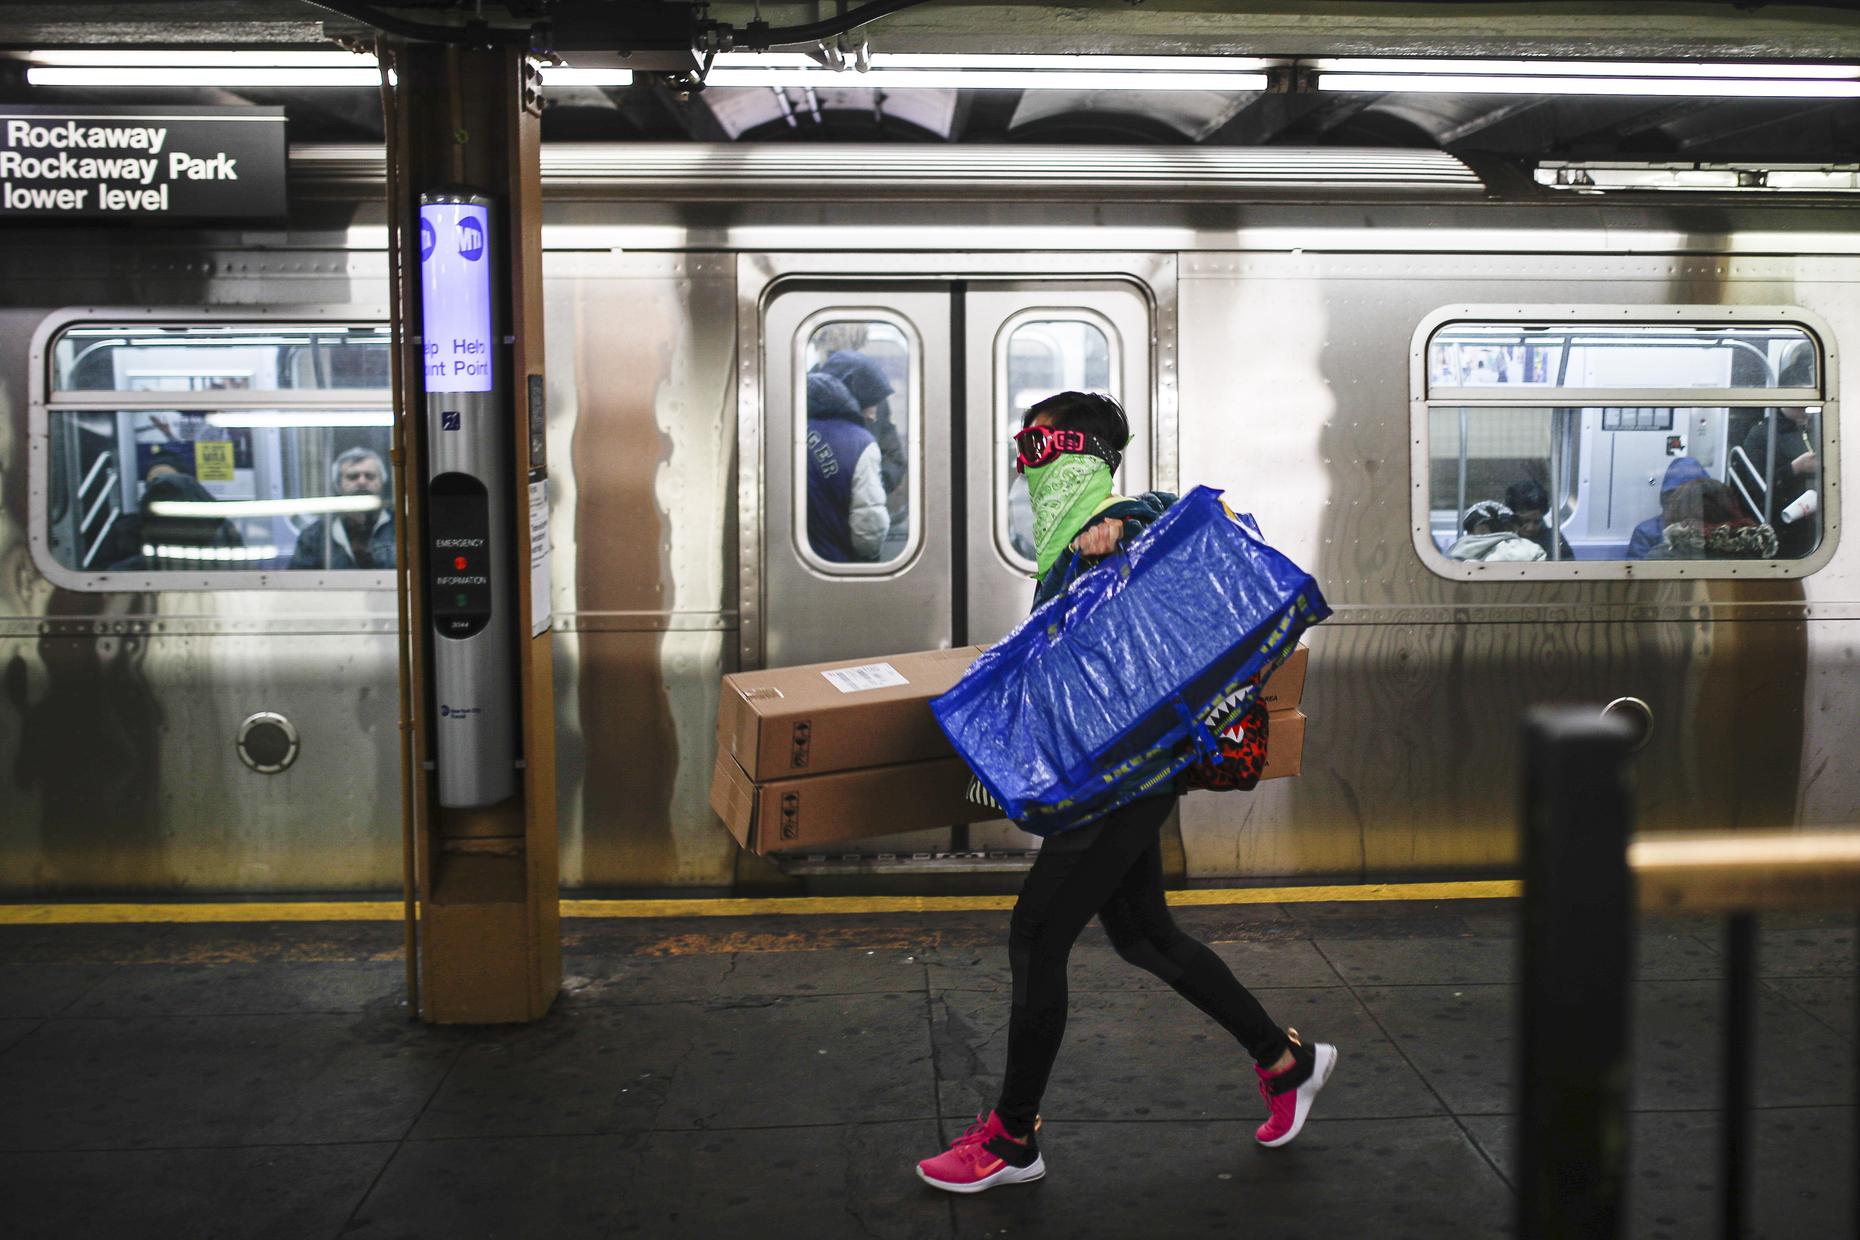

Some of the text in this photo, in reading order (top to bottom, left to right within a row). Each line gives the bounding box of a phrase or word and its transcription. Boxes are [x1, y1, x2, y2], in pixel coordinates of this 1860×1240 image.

[7, 120, 167, 154] Rockaway
[0, 152, 238, 184] Rockaway Park
[4, 182, 168, 210] lower level
[453, 339, 485, 359] Help
[454, 360, 488, 376] Point
[807, 430, 839, 479] GER
[436, 539, 484, 547] EMERGENCY
[437, 576, 486, 584] INFORMATION
